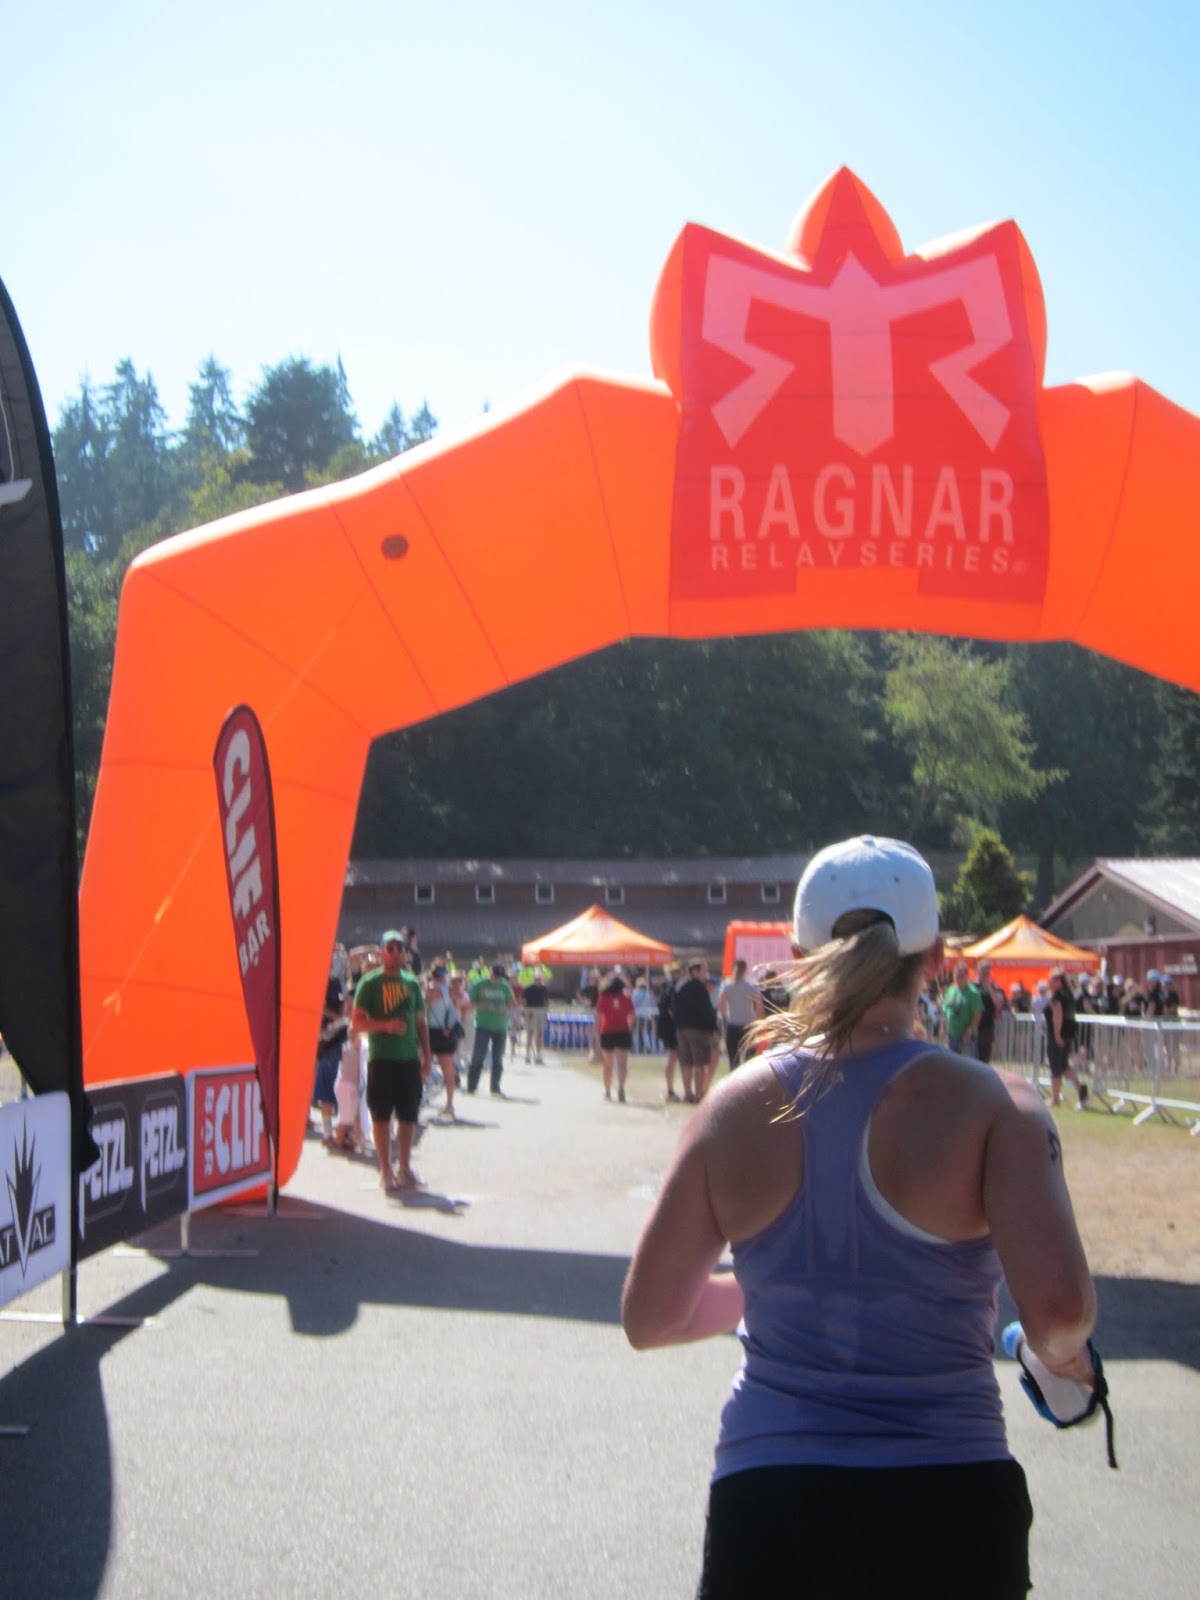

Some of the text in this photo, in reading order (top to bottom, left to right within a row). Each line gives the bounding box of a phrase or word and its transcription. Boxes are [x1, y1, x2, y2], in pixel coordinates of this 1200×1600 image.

[709, 463, 1015, 544] RAGNAR
[223, 728, 263, 920] CLIF
[239, 909, 271, 977] BAR
[141, 1105, 185, 1213] PETZL
